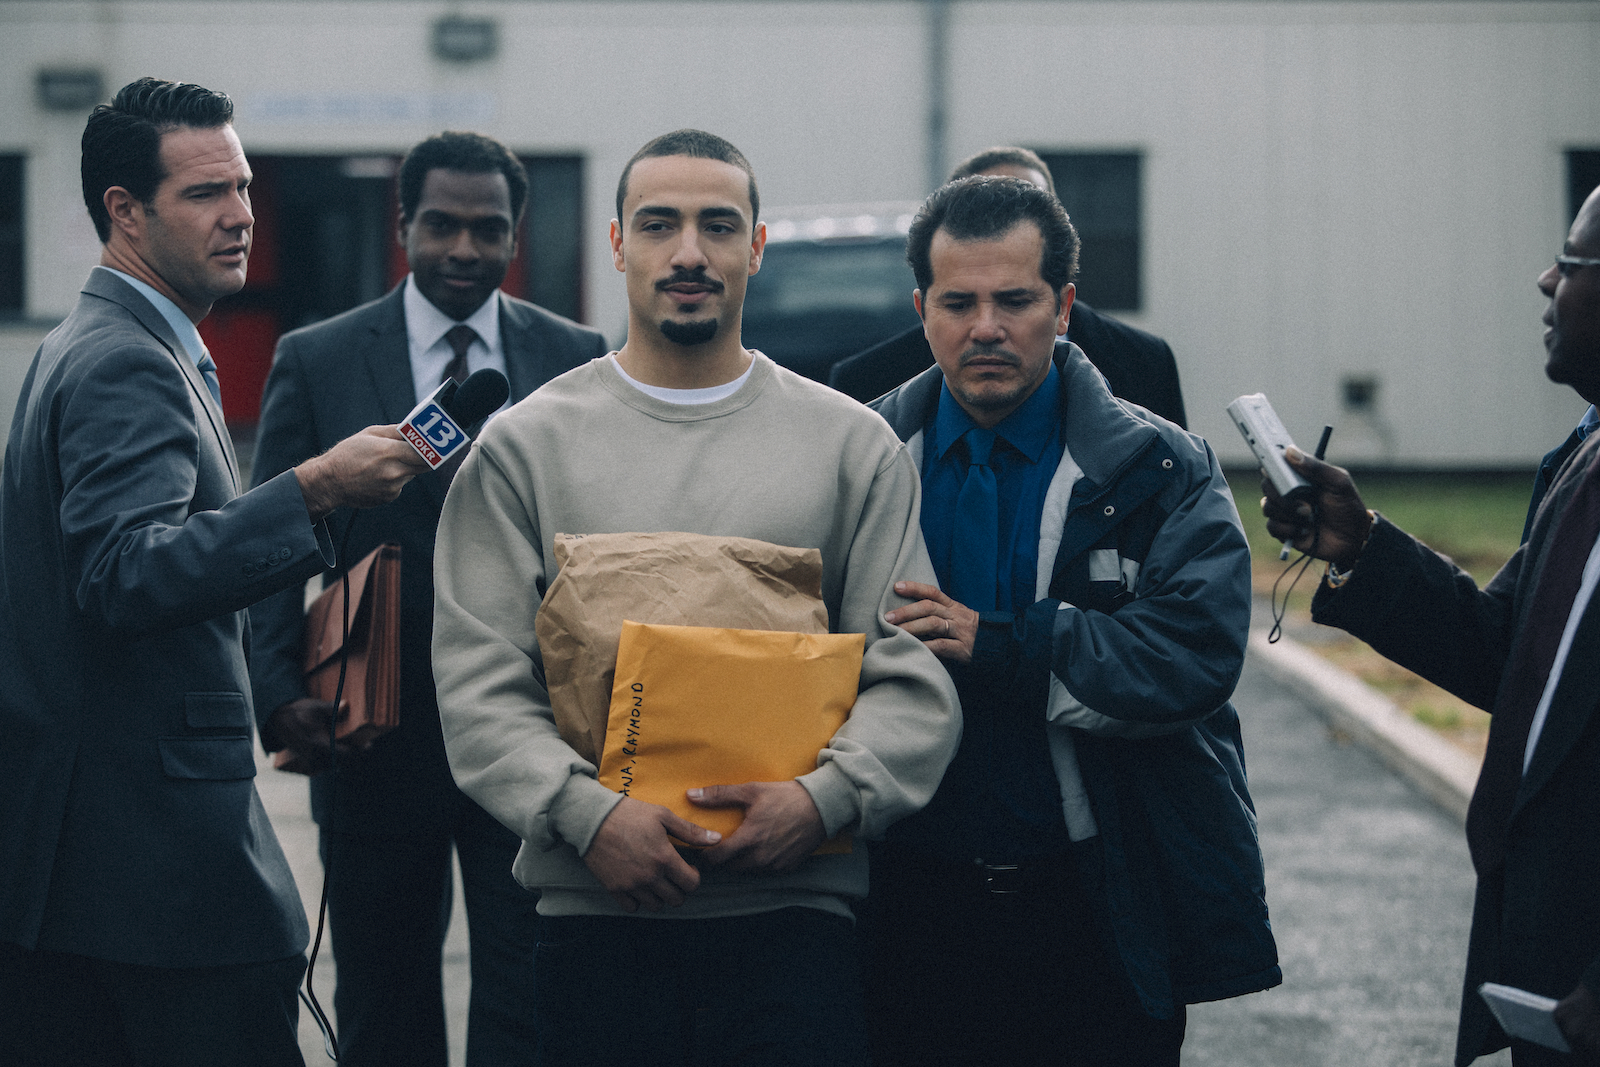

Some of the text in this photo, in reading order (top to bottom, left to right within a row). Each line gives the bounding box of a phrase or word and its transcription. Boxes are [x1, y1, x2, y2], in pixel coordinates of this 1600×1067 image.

[406, 428, 436, 461] WOKR
[416, 411, 457, 448] 13
[622, 682, 644, 756] RAYMOND
